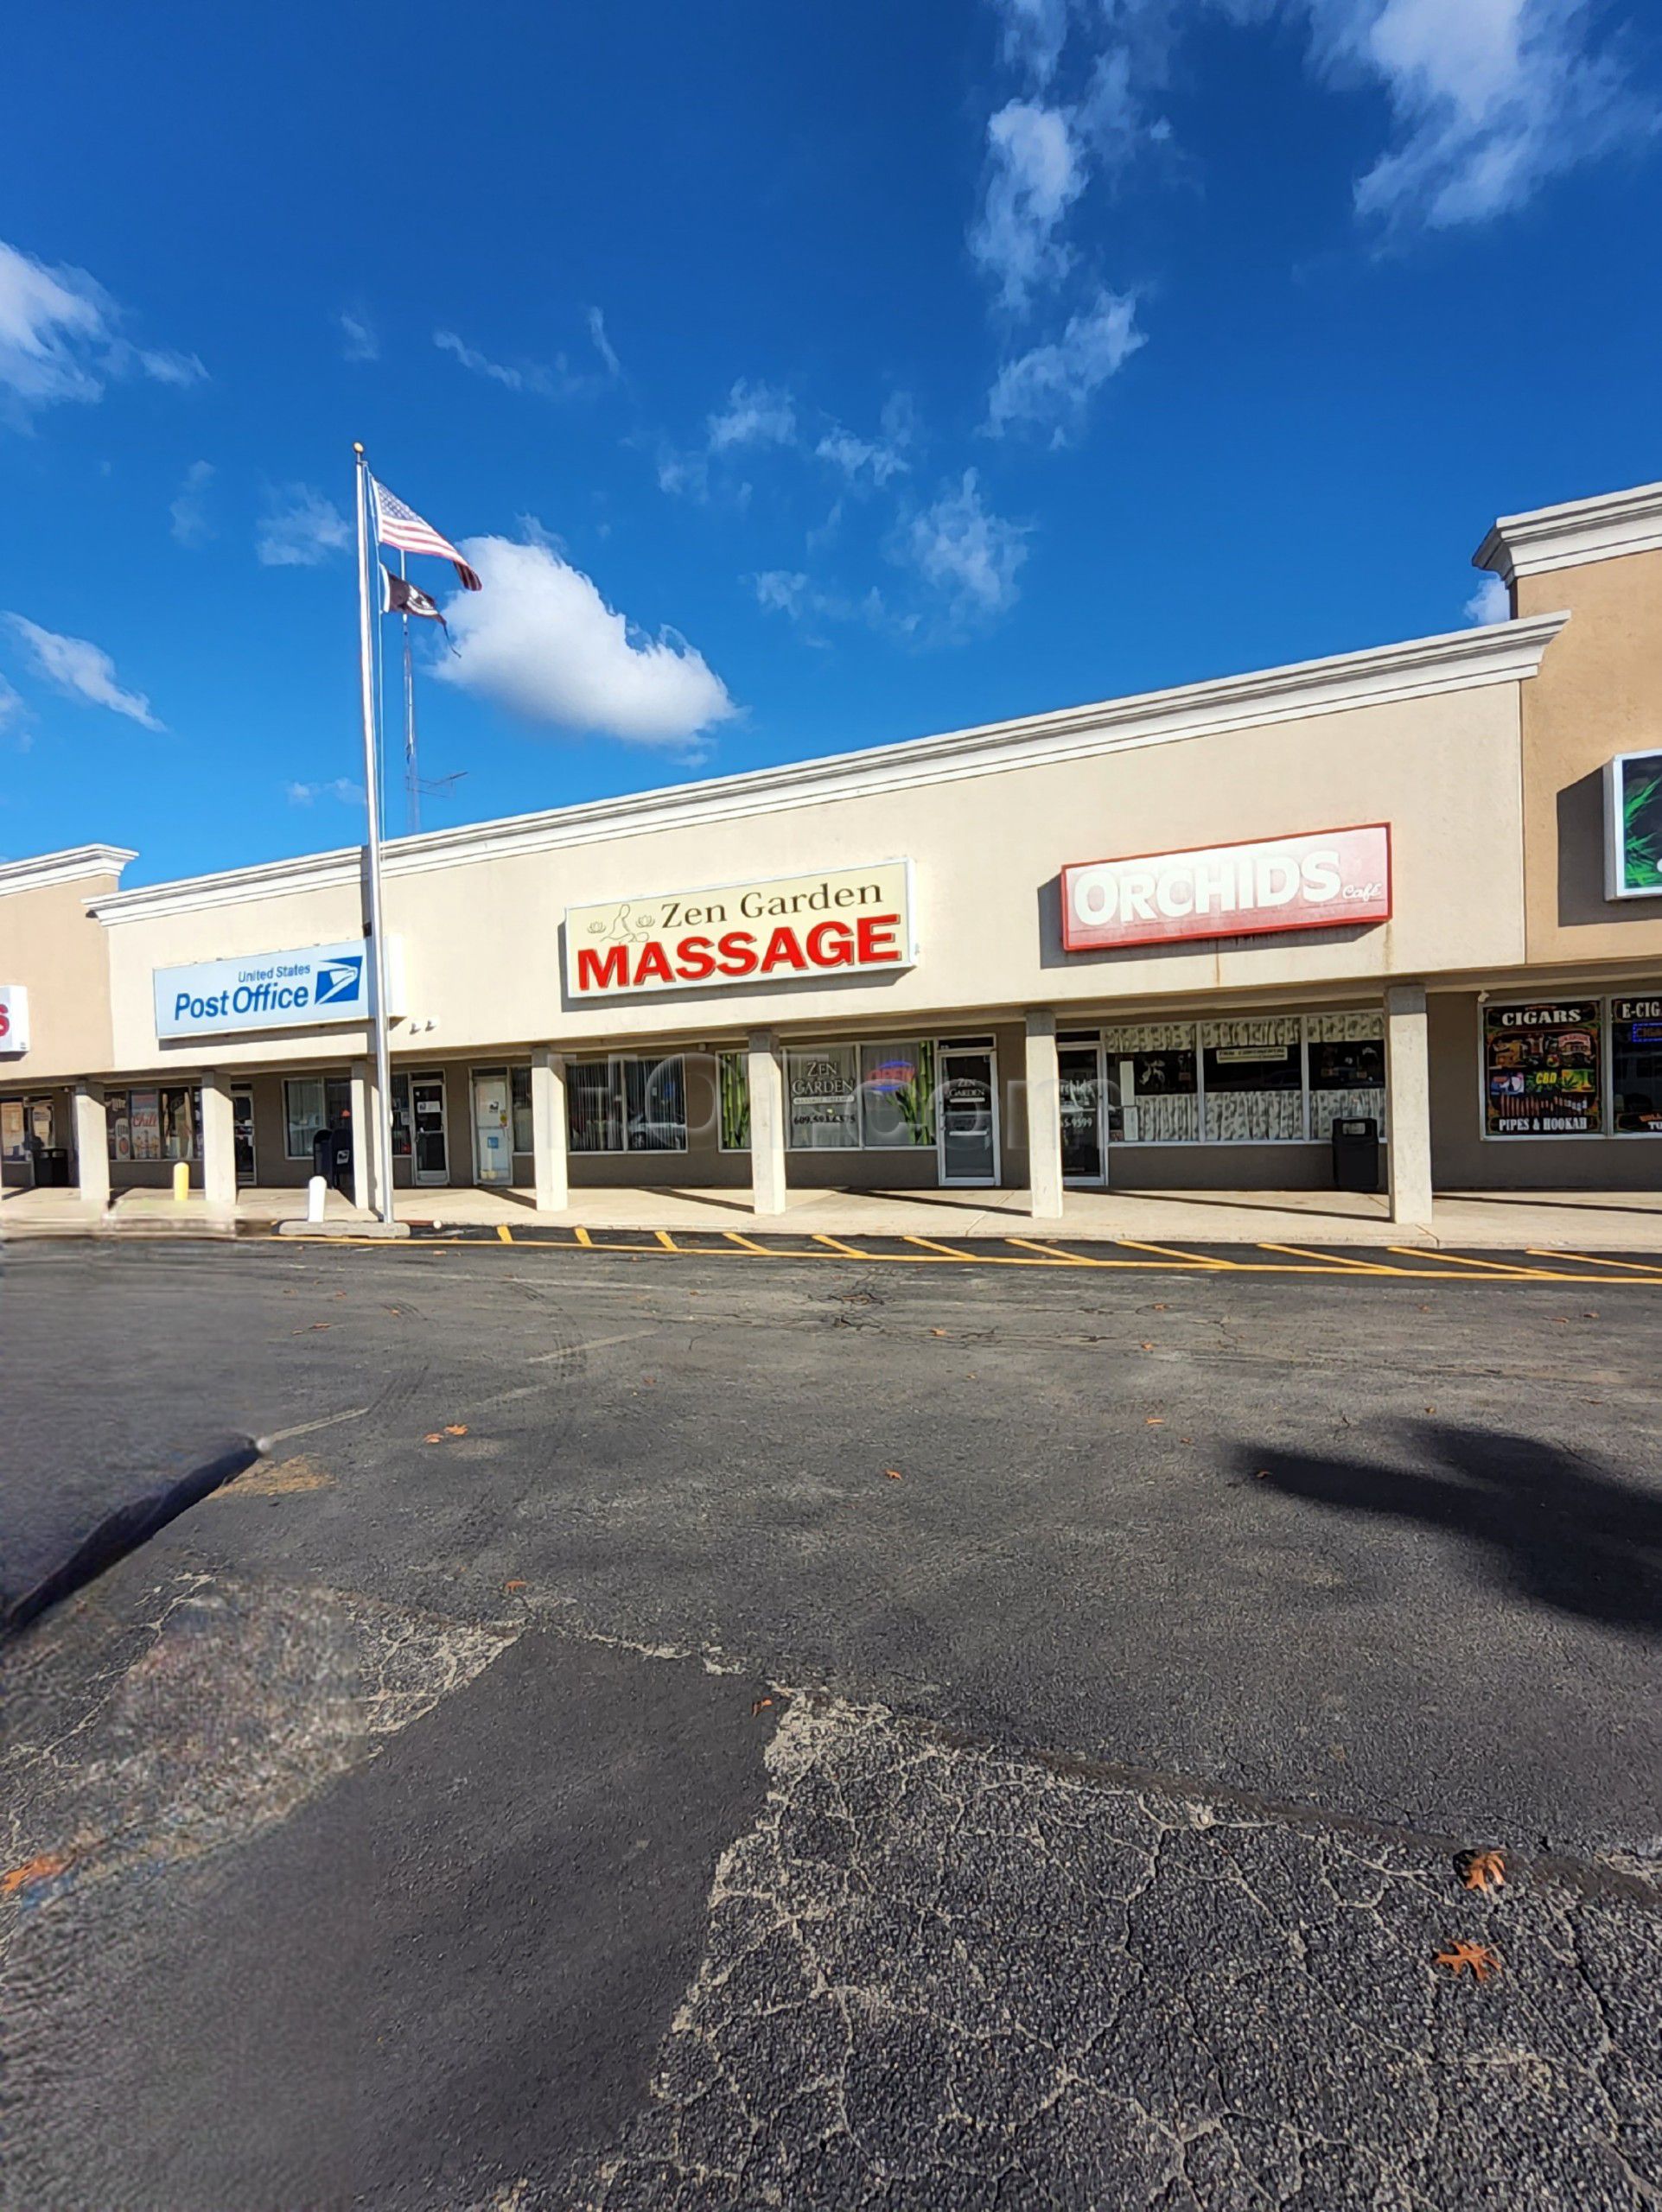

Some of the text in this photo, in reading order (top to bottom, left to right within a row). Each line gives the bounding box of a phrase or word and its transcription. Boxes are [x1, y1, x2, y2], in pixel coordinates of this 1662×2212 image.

[1073, 849, 1341, 926] ORCHIDS
[661, 881, 882, 929] Zen Garden
[576, 913, 902, 992] MASSAGE
[238, 963, 311, 983] United States
[174, 982, 309, 1021] Post Office
[1501, 1008, 1582, 1027] CIGARS
[791, 1079, 855, 1095] GARDEN
[1535, 1071, 1557, 1085] CBD
[1499, 1116, 1588, 1132] PIPES & HOOKAH
